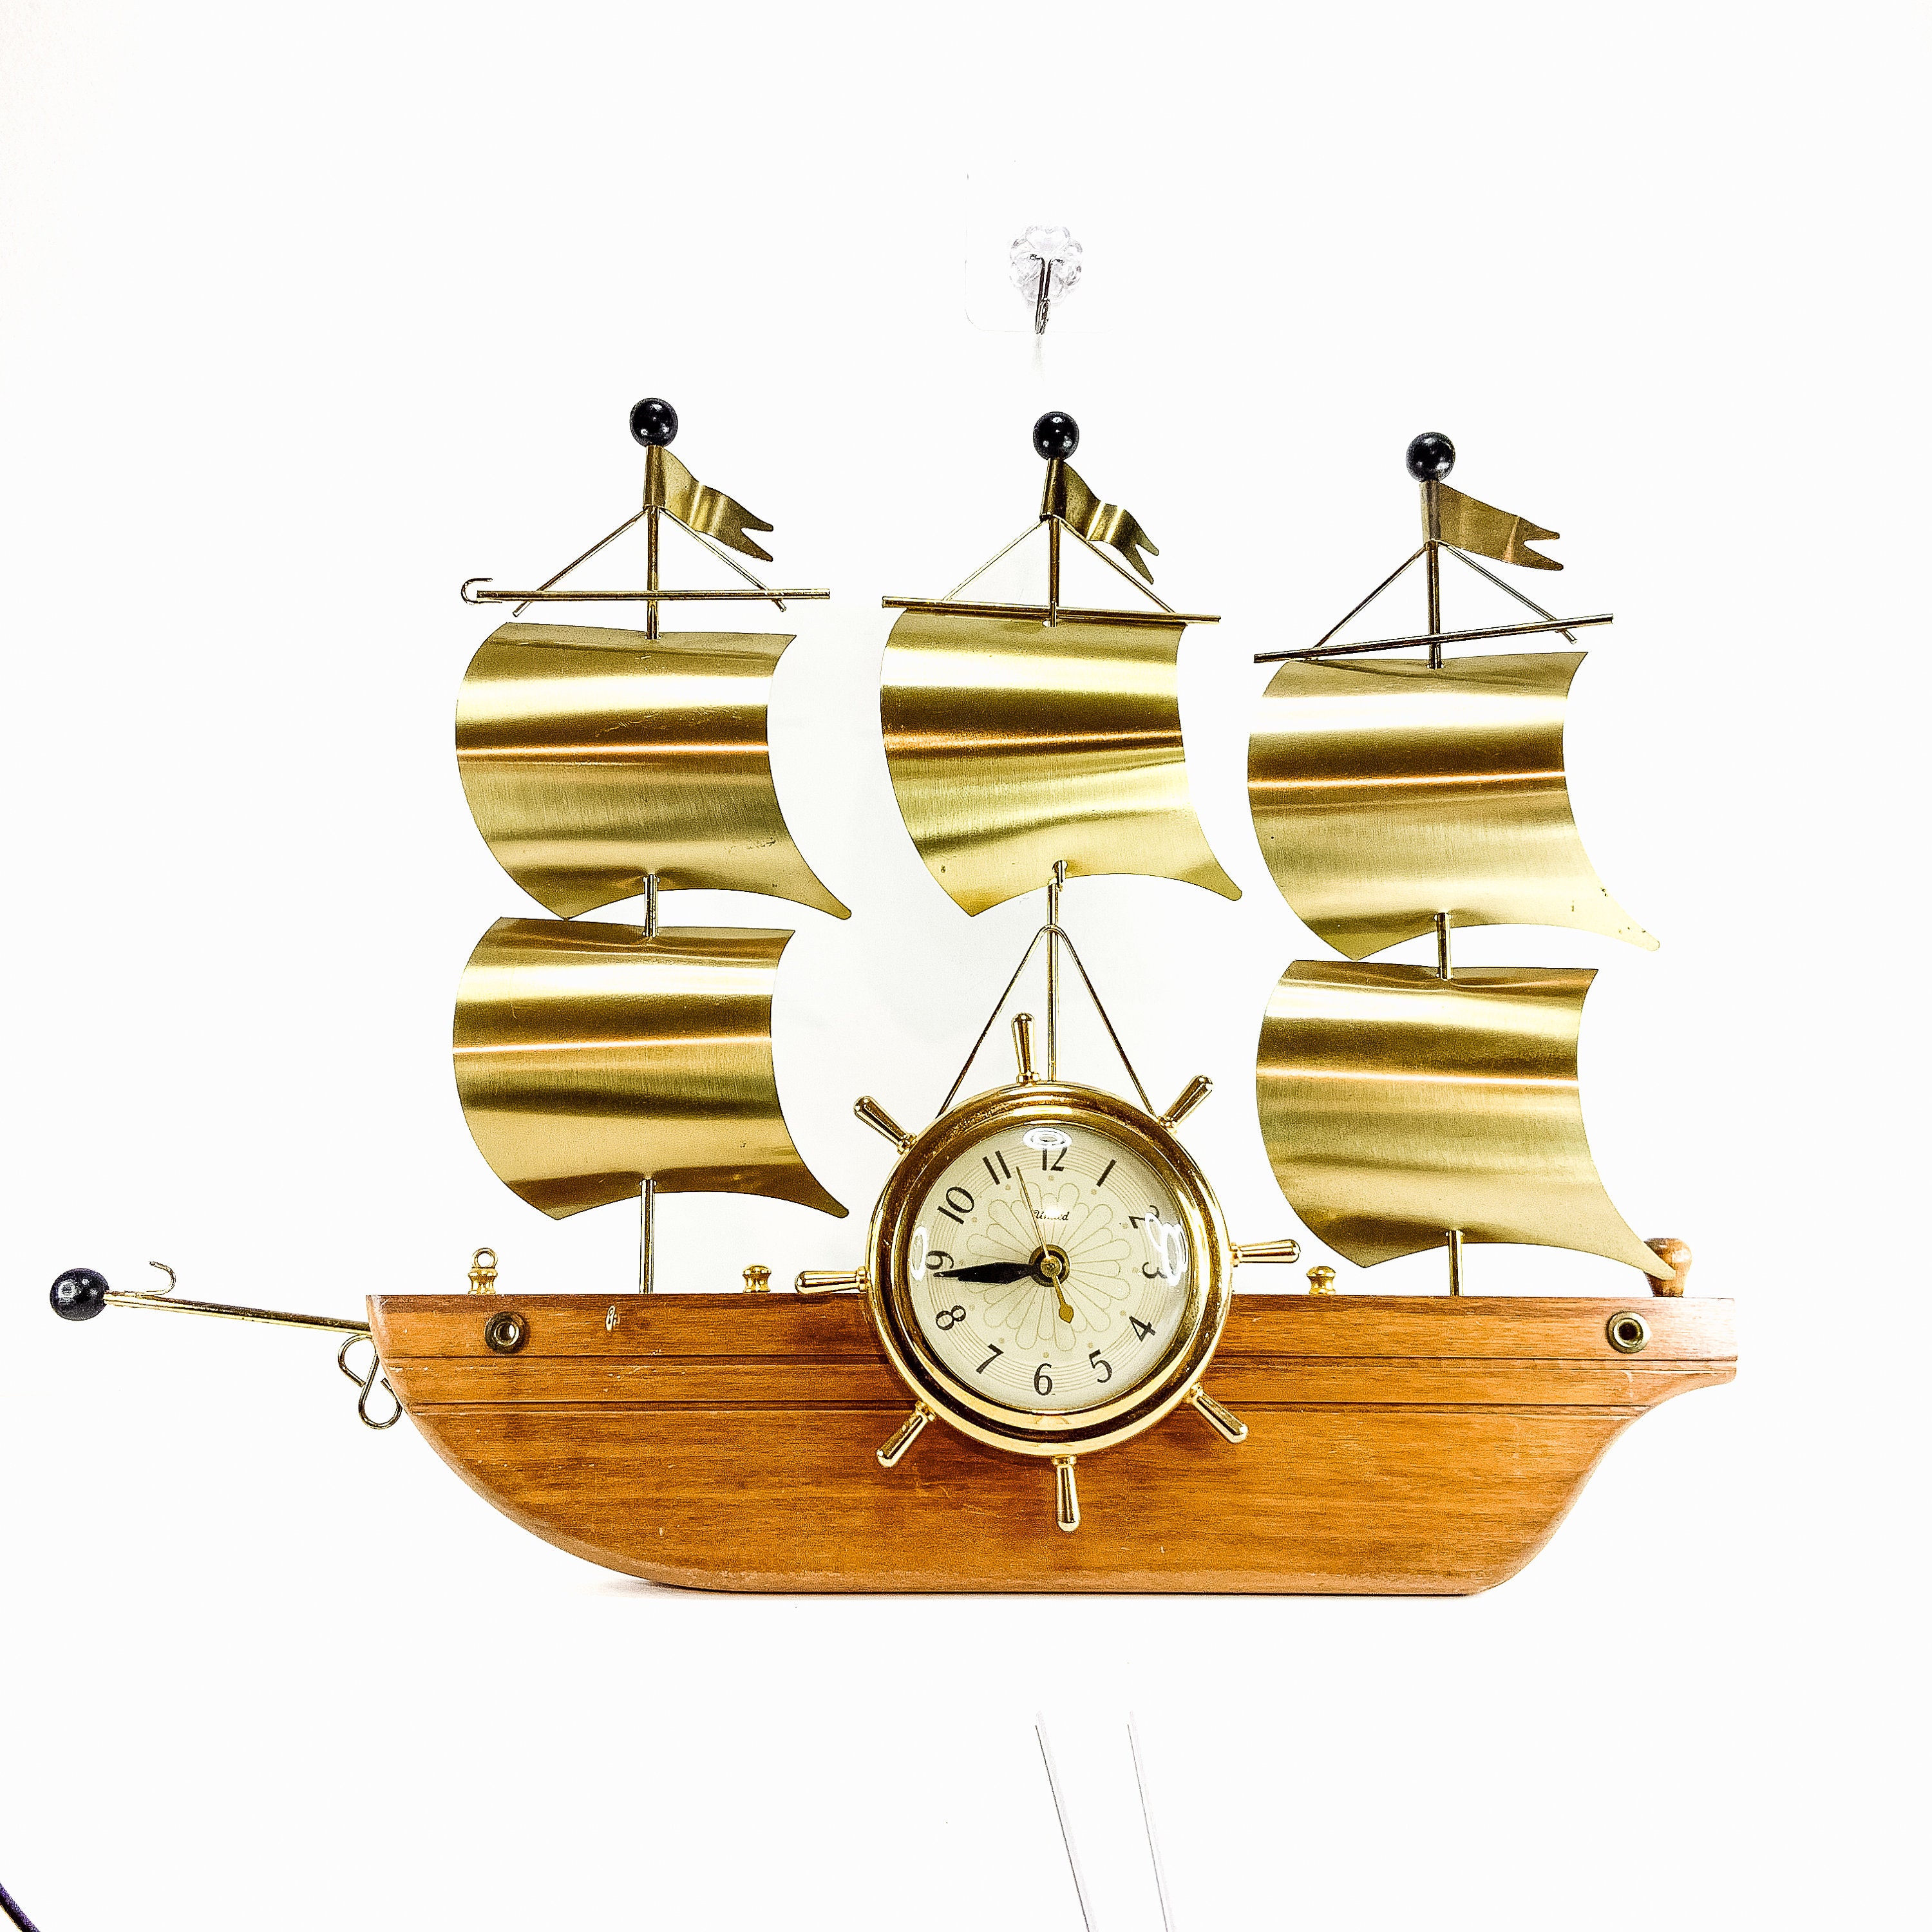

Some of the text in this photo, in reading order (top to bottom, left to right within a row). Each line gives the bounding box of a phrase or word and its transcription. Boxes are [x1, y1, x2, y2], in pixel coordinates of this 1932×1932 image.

[982, 1150, 1012, 1186] 11
[1042, 1146, 1068, 1171] 12
[1096, 1159, 1117, 1188] 1
[937, 1186, 974, 1224] 10
[1128, 1205, 1159, 1229] 2
[926, 1250, 954, 1270] 9
[1142, 1262, 1168, 1278] 3
[936, 1305, 966, 1331] 8
[1129, 1315, 1155, 1342] 4
[976, 1343, 1004, 1374] 7
[1088, 1349, 1113, 1383] 5
[1034, 1363, 1053, 1396] 6
